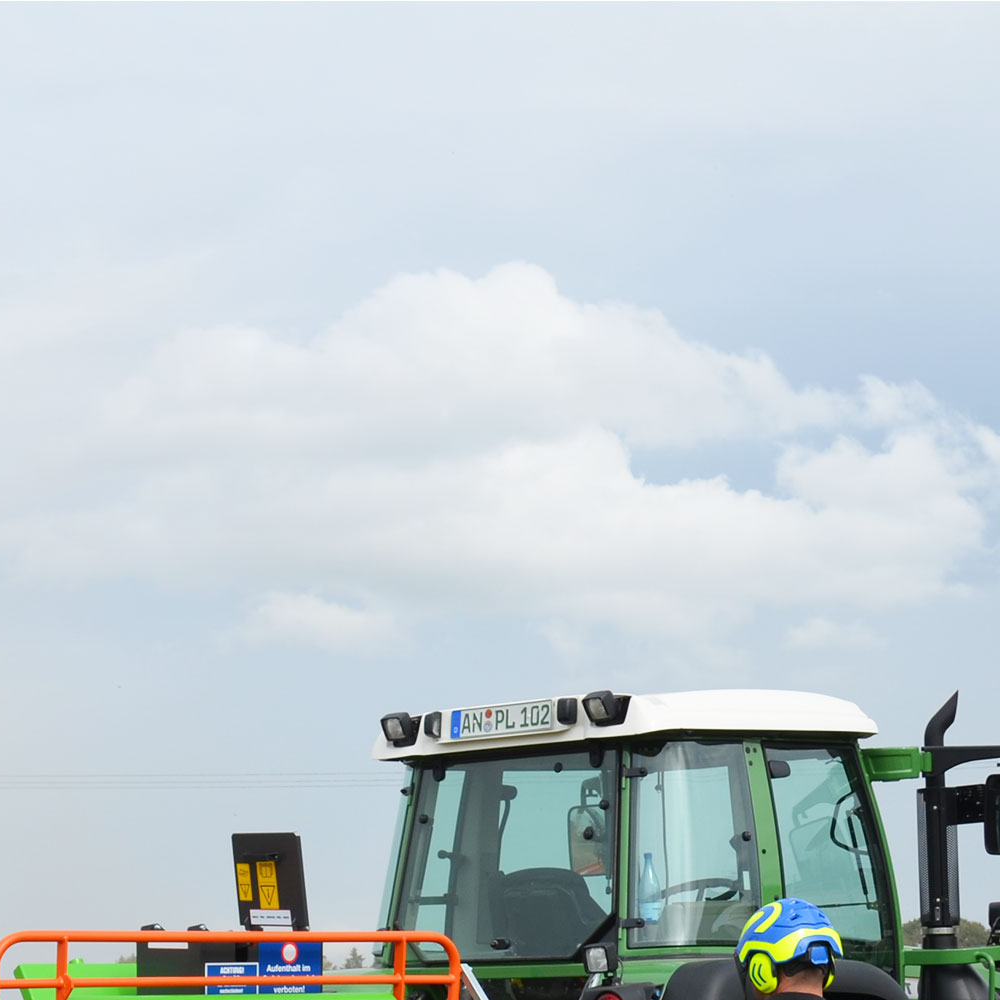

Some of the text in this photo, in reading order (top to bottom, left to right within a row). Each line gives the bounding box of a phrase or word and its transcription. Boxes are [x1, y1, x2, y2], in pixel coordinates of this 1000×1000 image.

[461, 712, 483, 734] AN
[495, 709, 515, 731] PL
[520, 704, 550, 728] 102
[266, 964, 311, 972] Aufenthalt im
[273, 985, 306, 994] verboten!
